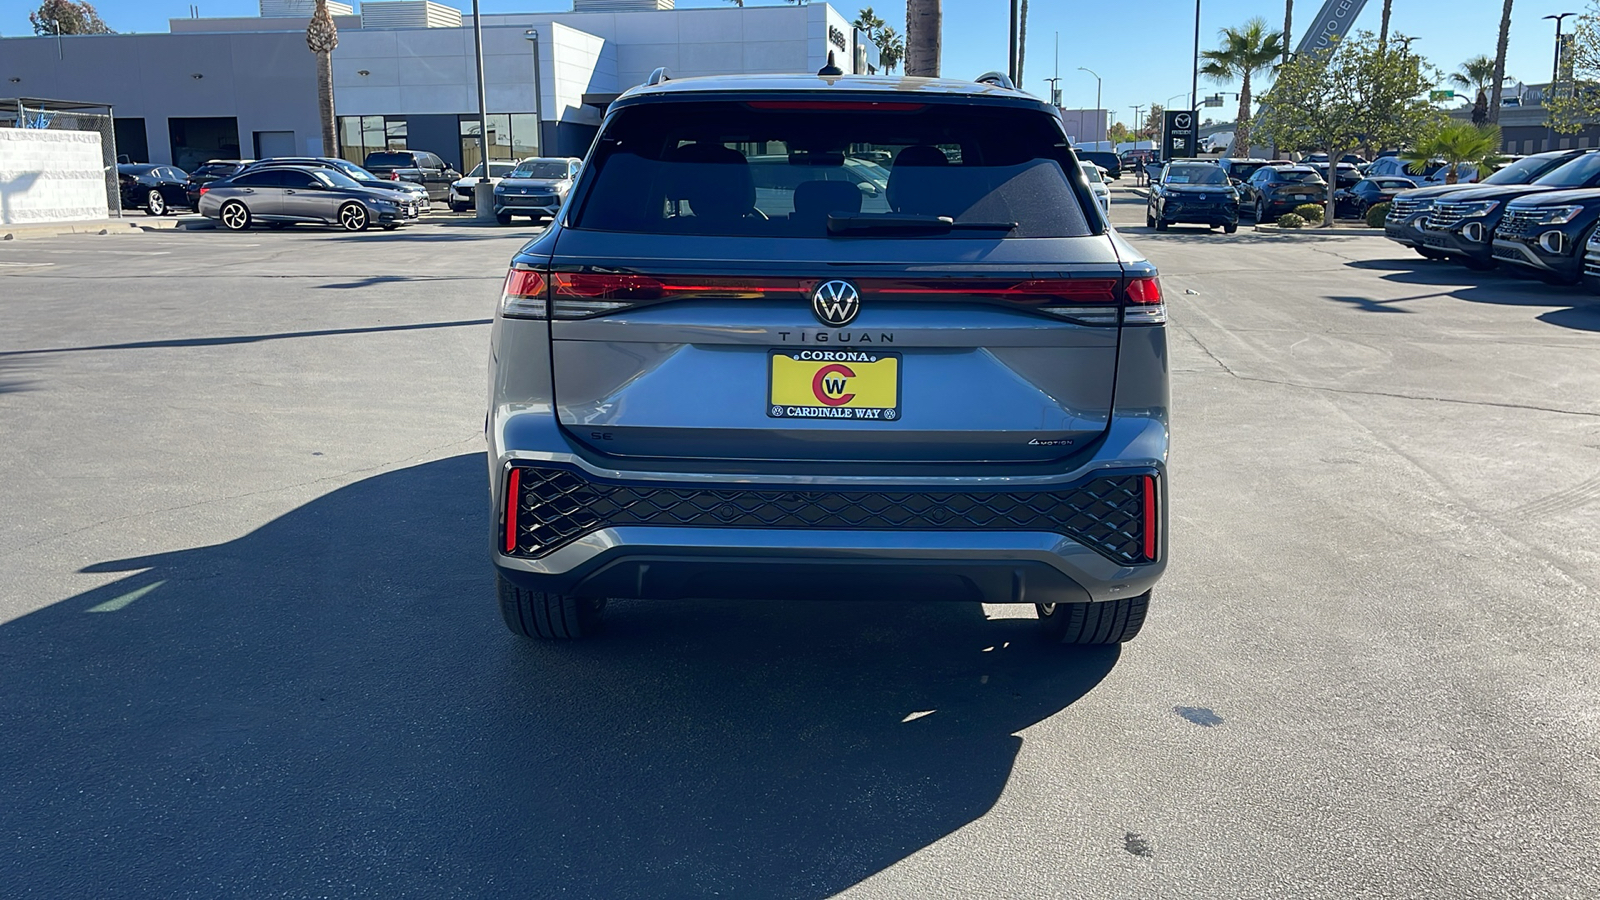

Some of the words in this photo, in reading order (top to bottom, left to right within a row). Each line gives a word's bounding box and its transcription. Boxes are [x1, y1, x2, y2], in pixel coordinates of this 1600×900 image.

[1335, 0, 1353, 18] CE
[778, 332, 894, 343] TIGUAN
[800, 350, 869, 362] CORONA
[786, 407, 853, 418] CARDINALE
[855, 408, 881, 419] WAY
[590, 431, 614, 441] SE
[1028, 438, 1073, 446] 4MOTION
